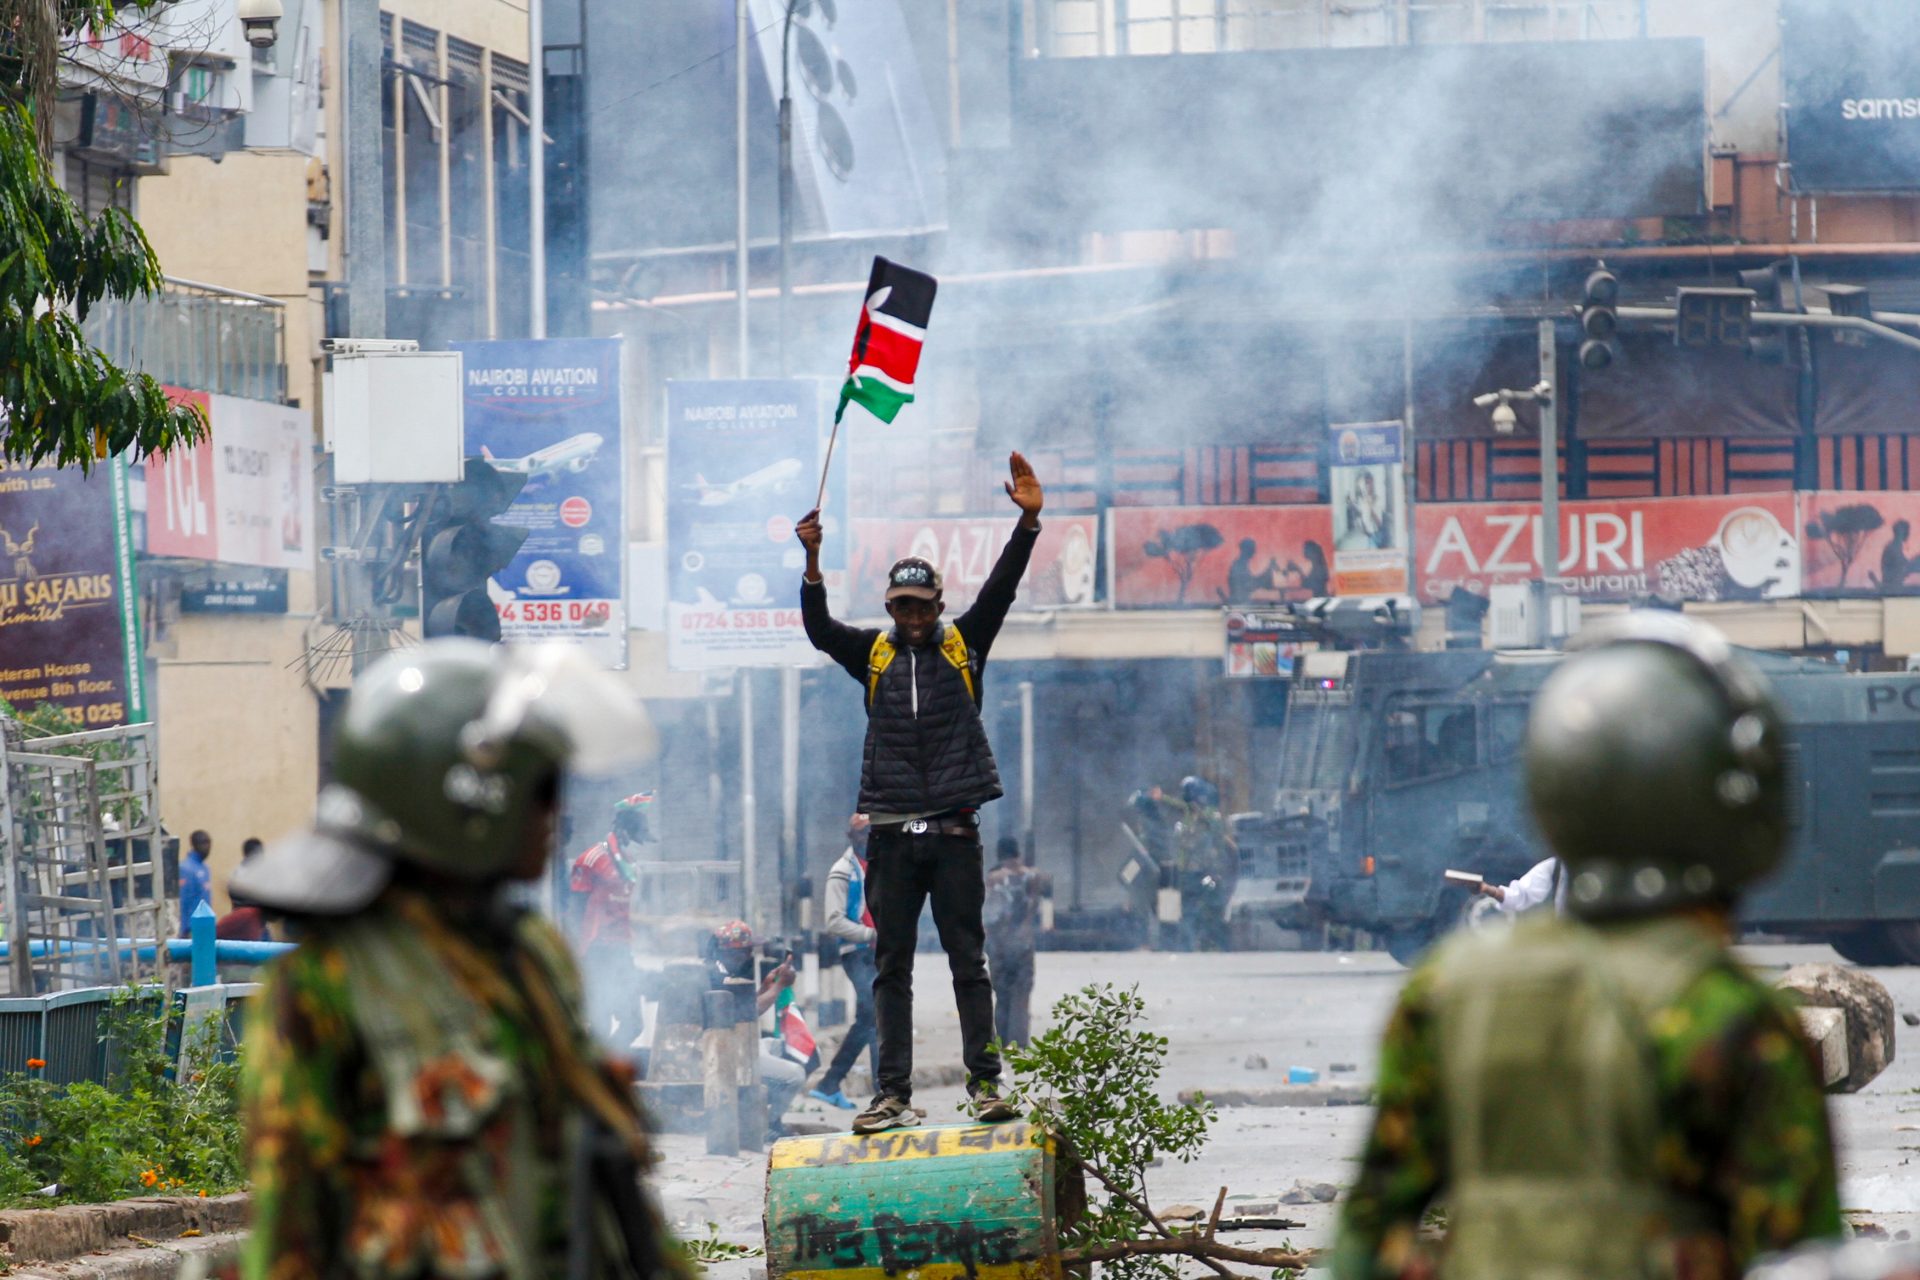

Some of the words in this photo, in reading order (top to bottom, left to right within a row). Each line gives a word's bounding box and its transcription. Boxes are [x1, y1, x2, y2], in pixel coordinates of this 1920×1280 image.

[1841, 97, 1920, 119] sams
[468, 368, 528, 385] NAIROBI
[530, 367, 599, 385] AVIATION
[493, 385, 576, 396] COLLEGE
[685, 405, 737, 421] NAIROBI
[738, 403, 798, 419] AVIATION
[1424, 510, 1644, 574] AZURI
[24, 574, 112, 606] SAFARIS
[523, 603, 563, 622] 536
[733, 610, 768, 628] 536
[774, 610, 804, 628] 04
[44, 663, 91, 678] House
[51, 682, 75, 698] 8th
[78, 679, 117, 694] floor.
[87, 702, 123, 722] 025
